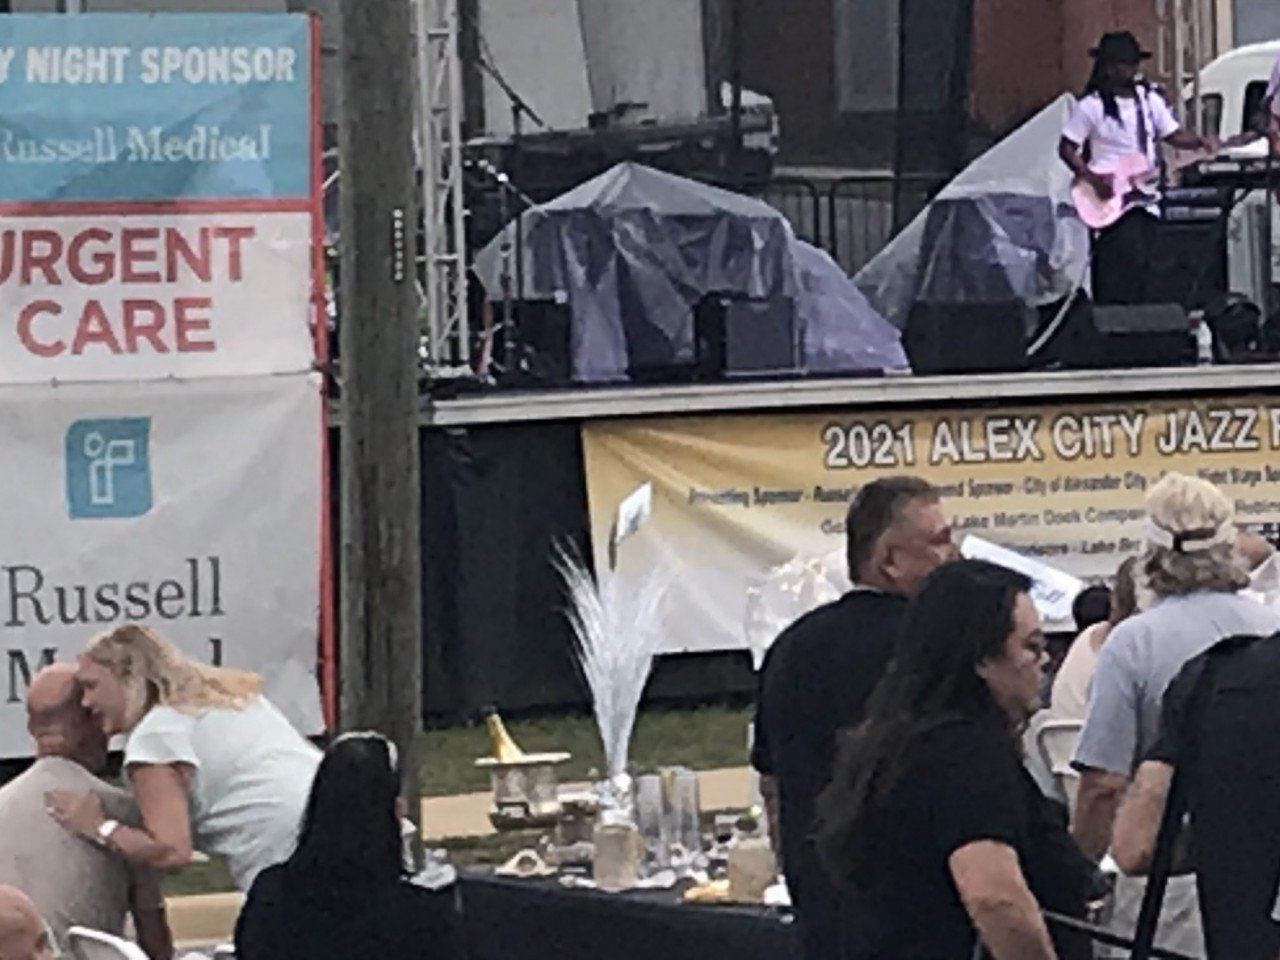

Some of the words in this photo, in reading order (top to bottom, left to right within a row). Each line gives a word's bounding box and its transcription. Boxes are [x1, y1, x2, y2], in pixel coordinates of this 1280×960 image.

[26, 46, 130, 84] NIGHT
[139, 46, 297, 84] SPONSOR
[126, 123, 273, 163] Medical
[15, 296, 218, 359] CARE
[822, 422, 915, 469] 2021
[930, 416, 1043, 464] ALEX
[1052, 412, 1147, 458] CITY
[1158, 407, 1260, 454] JAZZ
[1, 555, 226, 628] Russell
